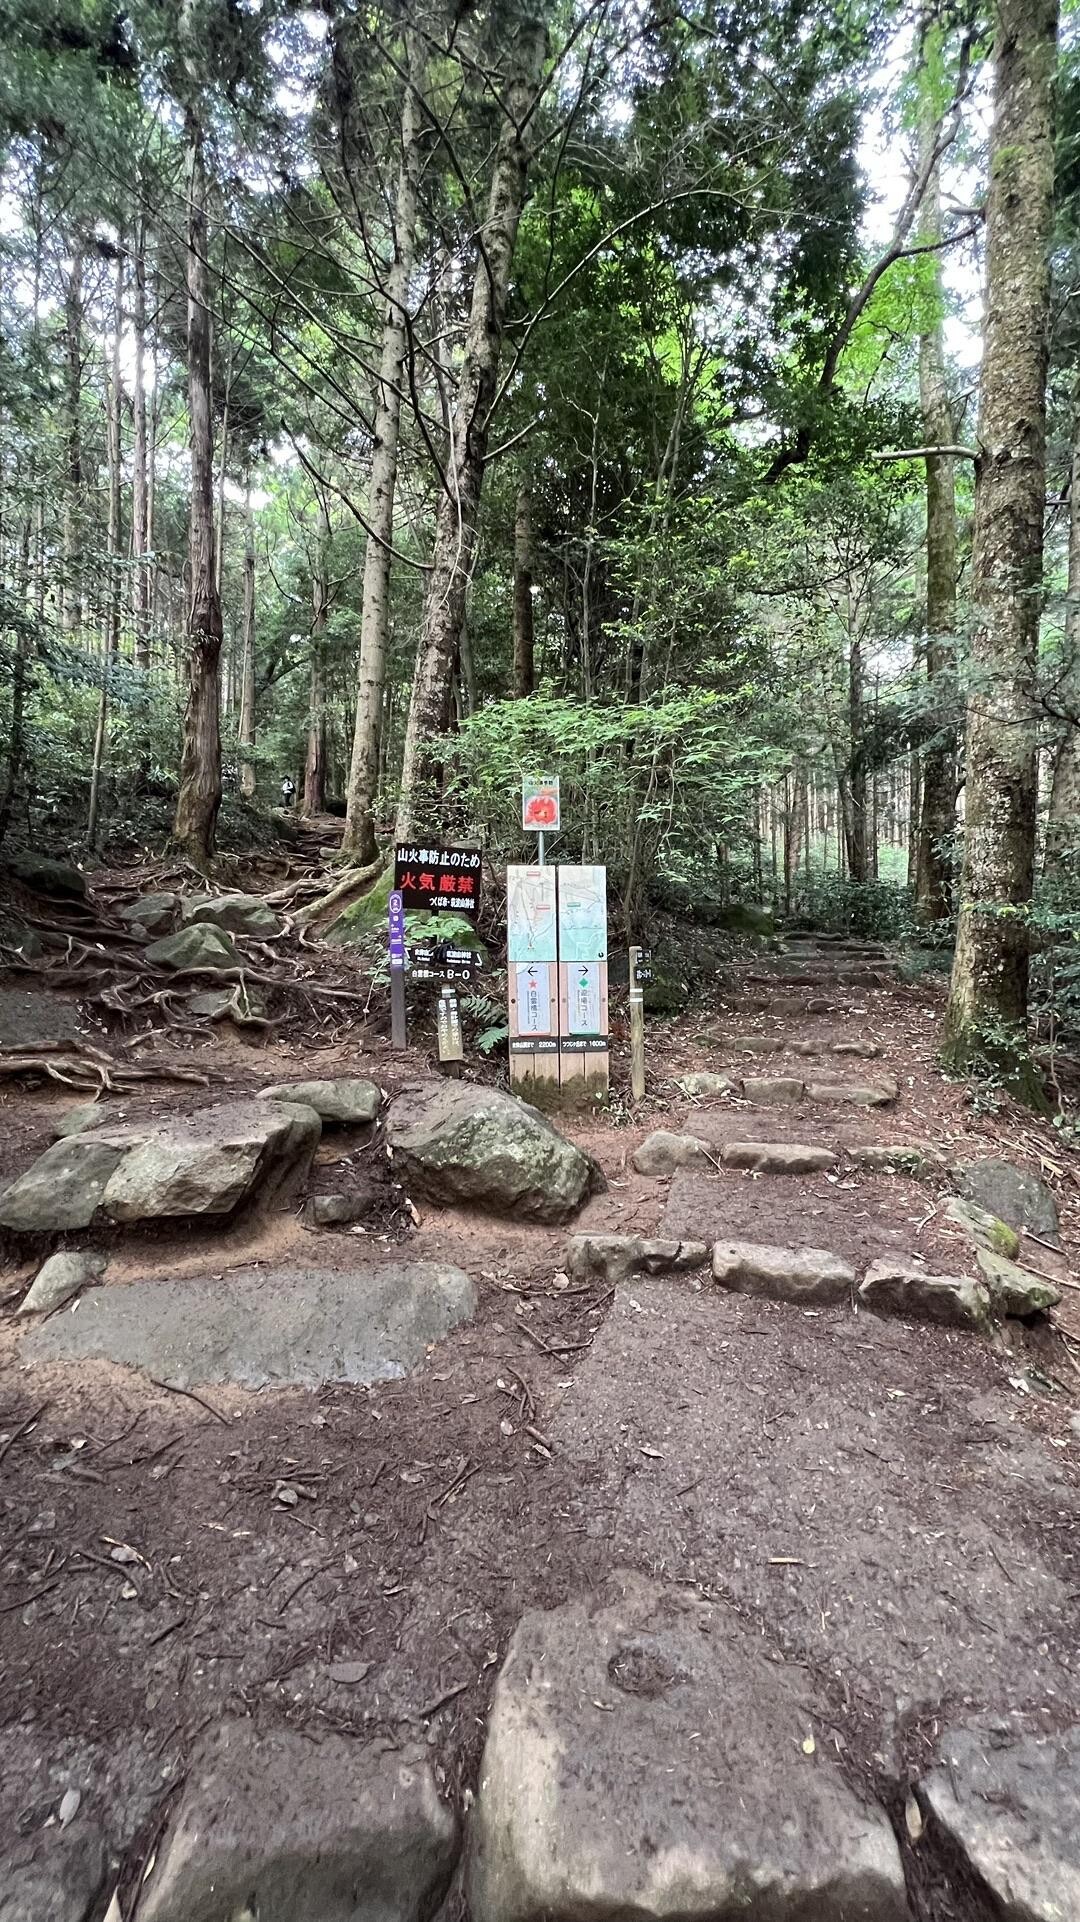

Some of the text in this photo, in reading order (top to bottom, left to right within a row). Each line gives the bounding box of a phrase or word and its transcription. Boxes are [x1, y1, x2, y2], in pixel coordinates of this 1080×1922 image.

[398, 847, 480, 868] 山火事防止のため
[400, 871, 474, 893] 火気厳禁
